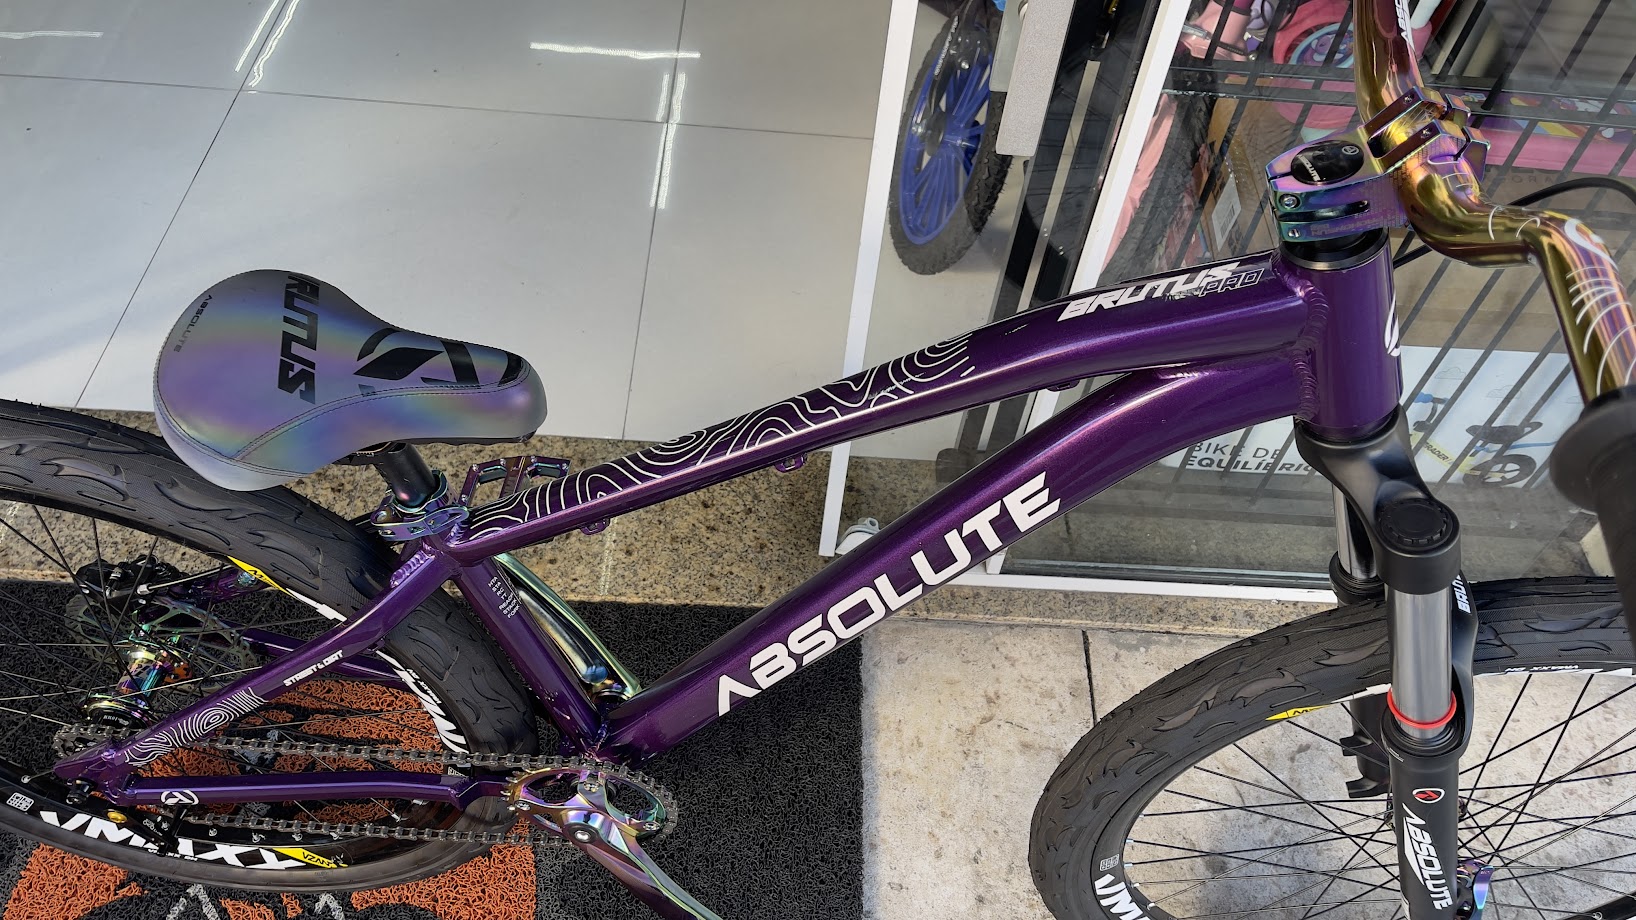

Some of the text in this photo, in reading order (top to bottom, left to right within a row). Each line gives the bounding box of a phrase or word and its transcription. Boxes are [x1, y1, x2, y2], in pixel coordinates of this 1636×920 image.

[173, 294, 213, 353] ABSOLUTE
[1057, 261, 1265, 322] BRUTUS PRO
[277, 273, 321, 404] RUTUS
[717, 471, 1061, 716] ABSOLUTE
[283, 664, 318, 687] STREET
[322, 649, 343, 666] DIRT
[1402, 802, 1454, 910] ABSOLUTE
